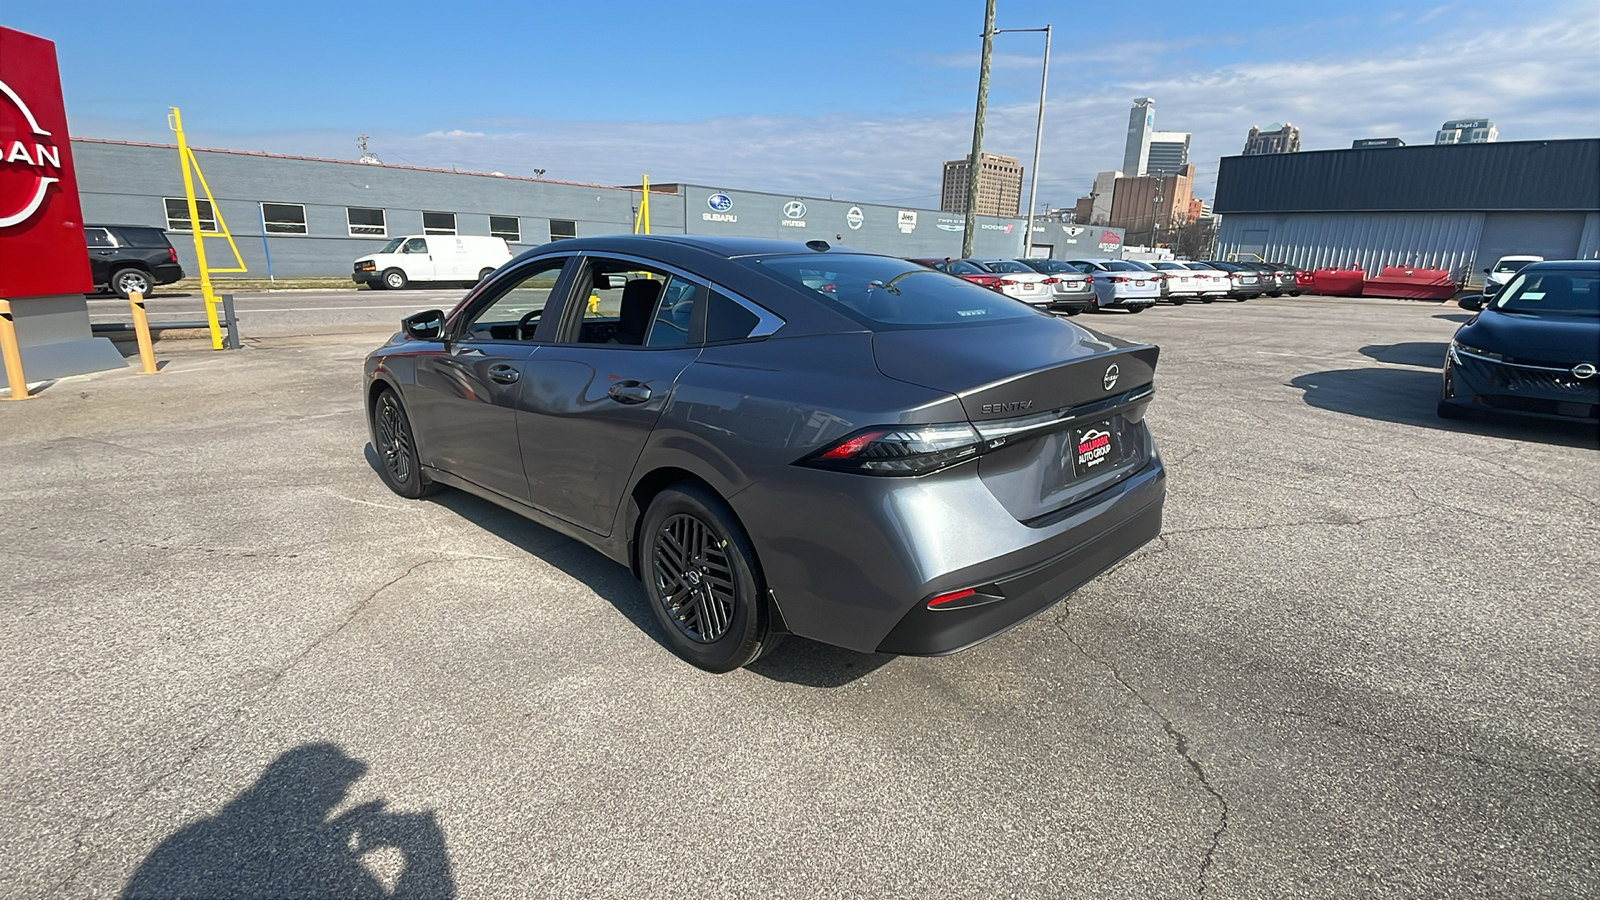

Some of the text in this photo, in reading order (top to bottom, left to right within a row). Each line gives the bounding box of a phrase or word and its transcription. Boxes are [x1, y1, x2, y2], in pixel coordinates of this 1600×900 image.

[0, 140, 61, 168] AN
[702, 213, 737, 223] SUBARU
[781, 219, 806, 228] HYUNDAI
[901, 213, 914, 221] Jeep
[981, 400, 1033, 414] SENTRA
[1078, 435, 1109, 455] HALLMARK
[1078, 451, 1094, 465] AUTO
[1093, 444, 1111, 459] GROUP
